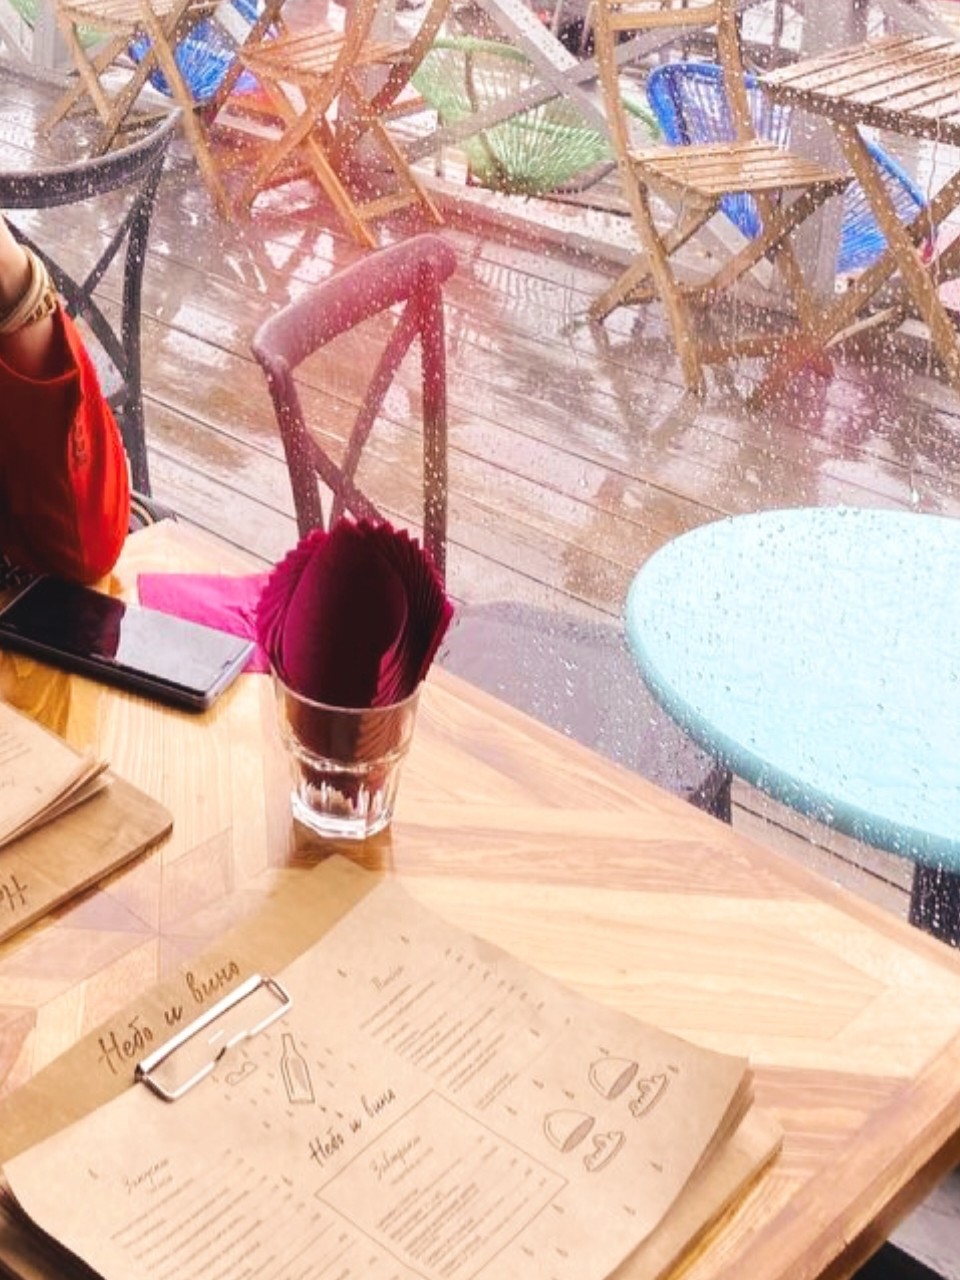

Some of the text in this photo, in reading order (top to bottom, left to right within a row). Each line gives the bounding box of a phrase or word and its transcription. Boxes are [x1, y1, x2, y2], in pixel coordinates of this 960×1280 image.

[98, 959, 241, 1076] Небо и вино
[308, 1125, 345, 1168] Небо
